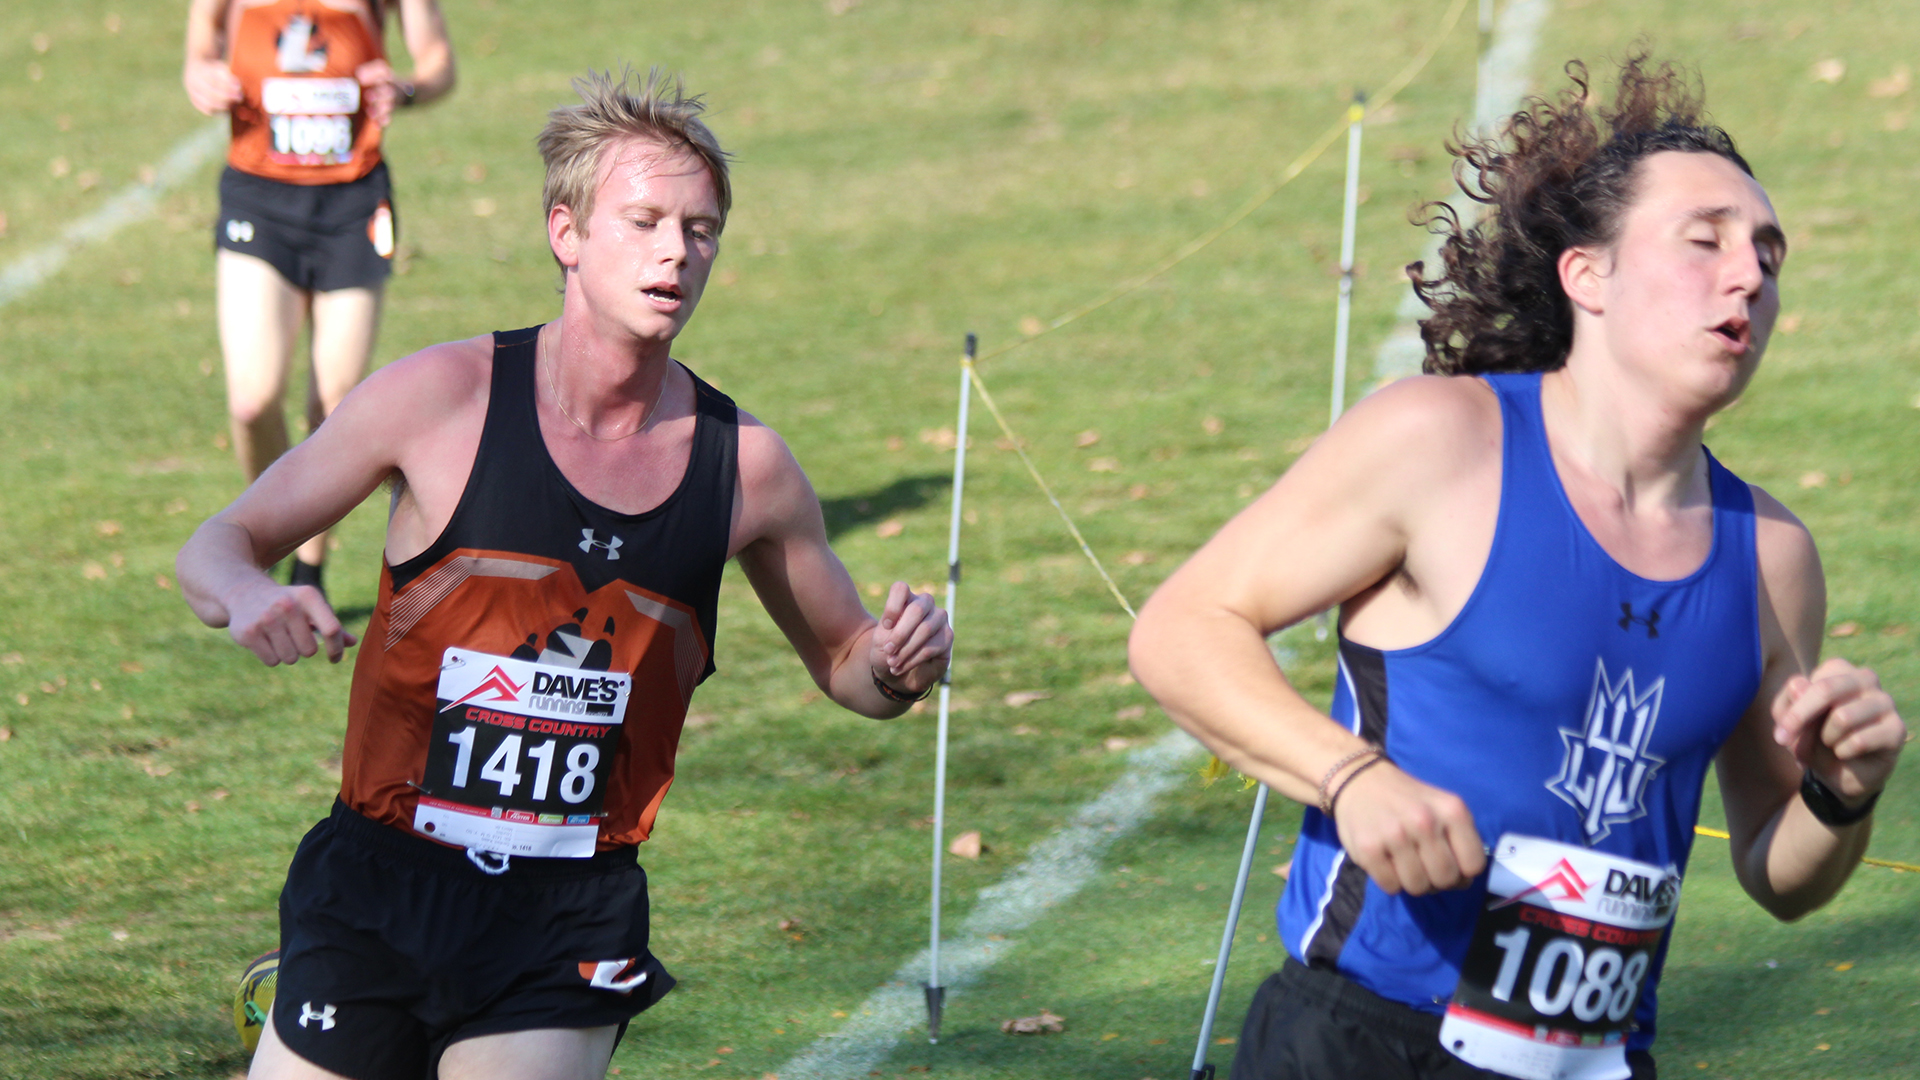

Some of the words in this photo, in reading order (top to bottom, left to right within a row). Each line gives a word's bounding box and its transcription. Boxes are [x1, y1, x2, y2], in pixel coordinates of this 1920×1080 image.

[528, 694, 586, 715] running
[531, 671, 618, 702] DAVE'S
[465, 707, 526, 730] CROSS
[527, 719, 612, 738] COUNTRY
[448, 726, 600, 804] 1418
[1519, 904, 1592, 938] CROSS
[1591, 922, 1658, 946] COUN
[1491, 926, 1649, 1023] 1088
